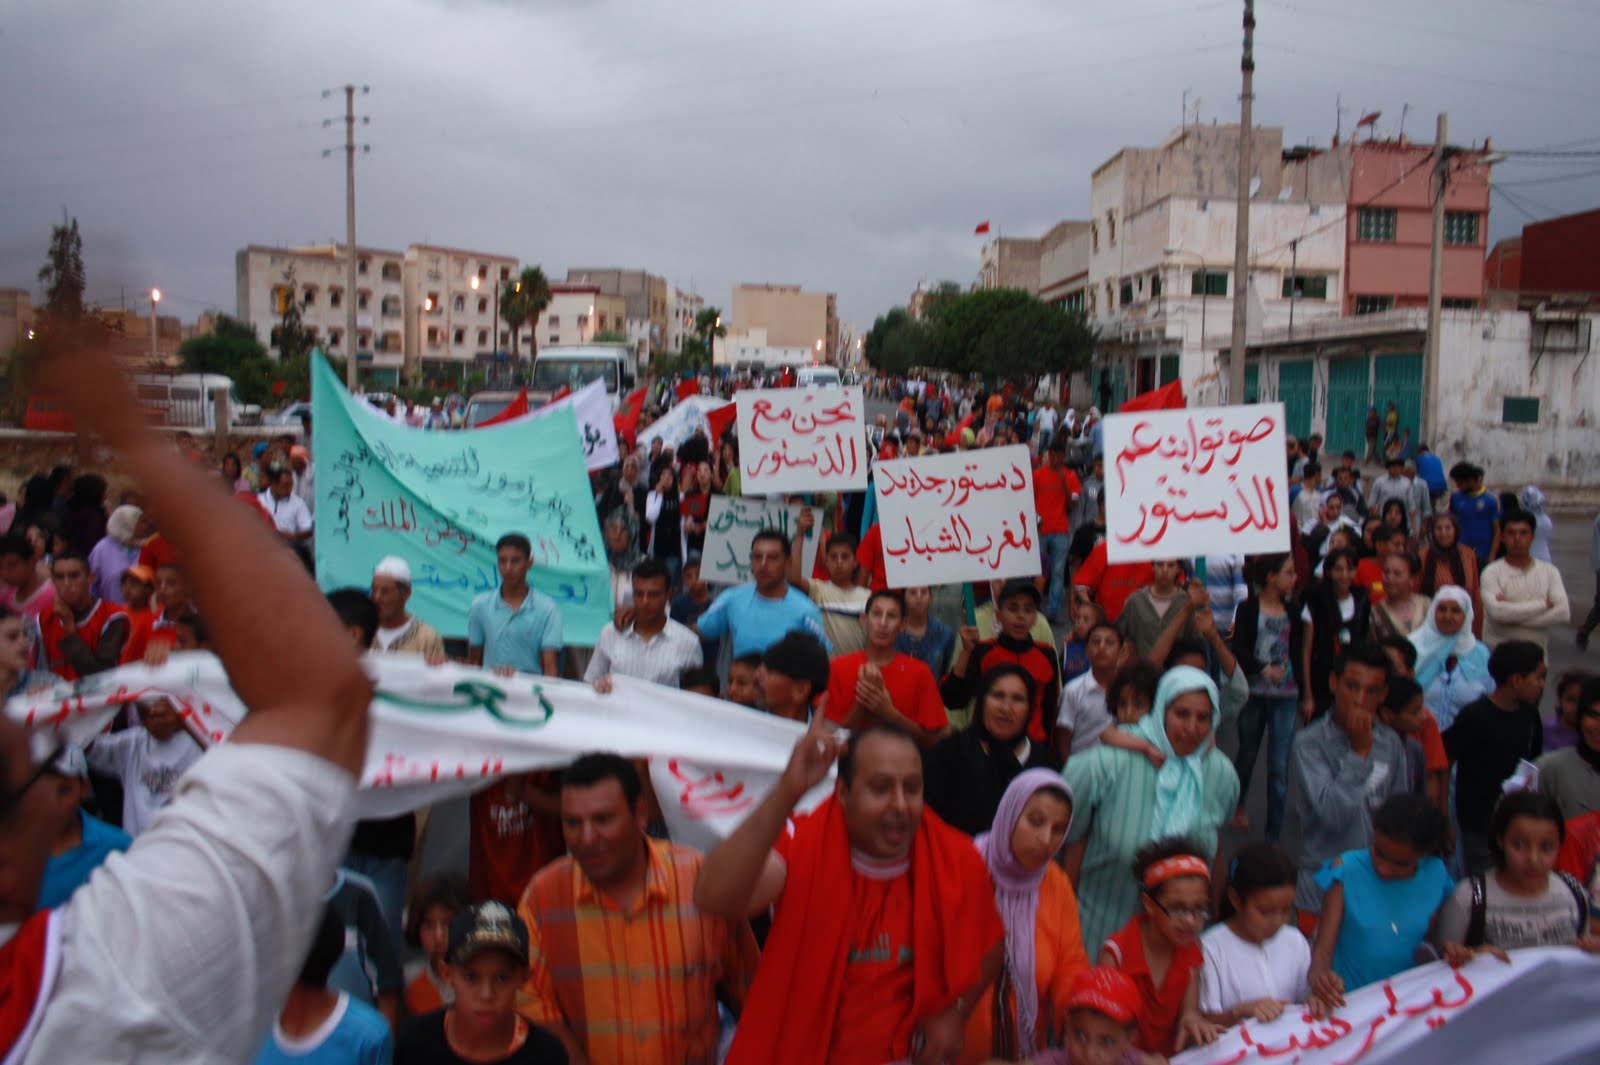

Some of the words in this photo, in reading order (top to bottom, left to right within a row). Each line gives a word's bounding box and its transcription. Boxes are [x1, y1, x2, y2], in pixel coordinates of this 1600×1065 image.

[750, 399, 792, 442] مع
[1187, 415, 1276, 475] صوتوا
[880, 466, 947, 498] جديد
[941, 463, 1026, 507] دستور
[1115, 472, 1279, 547] للدستور
[886, 513, 972, 564] الشباب
